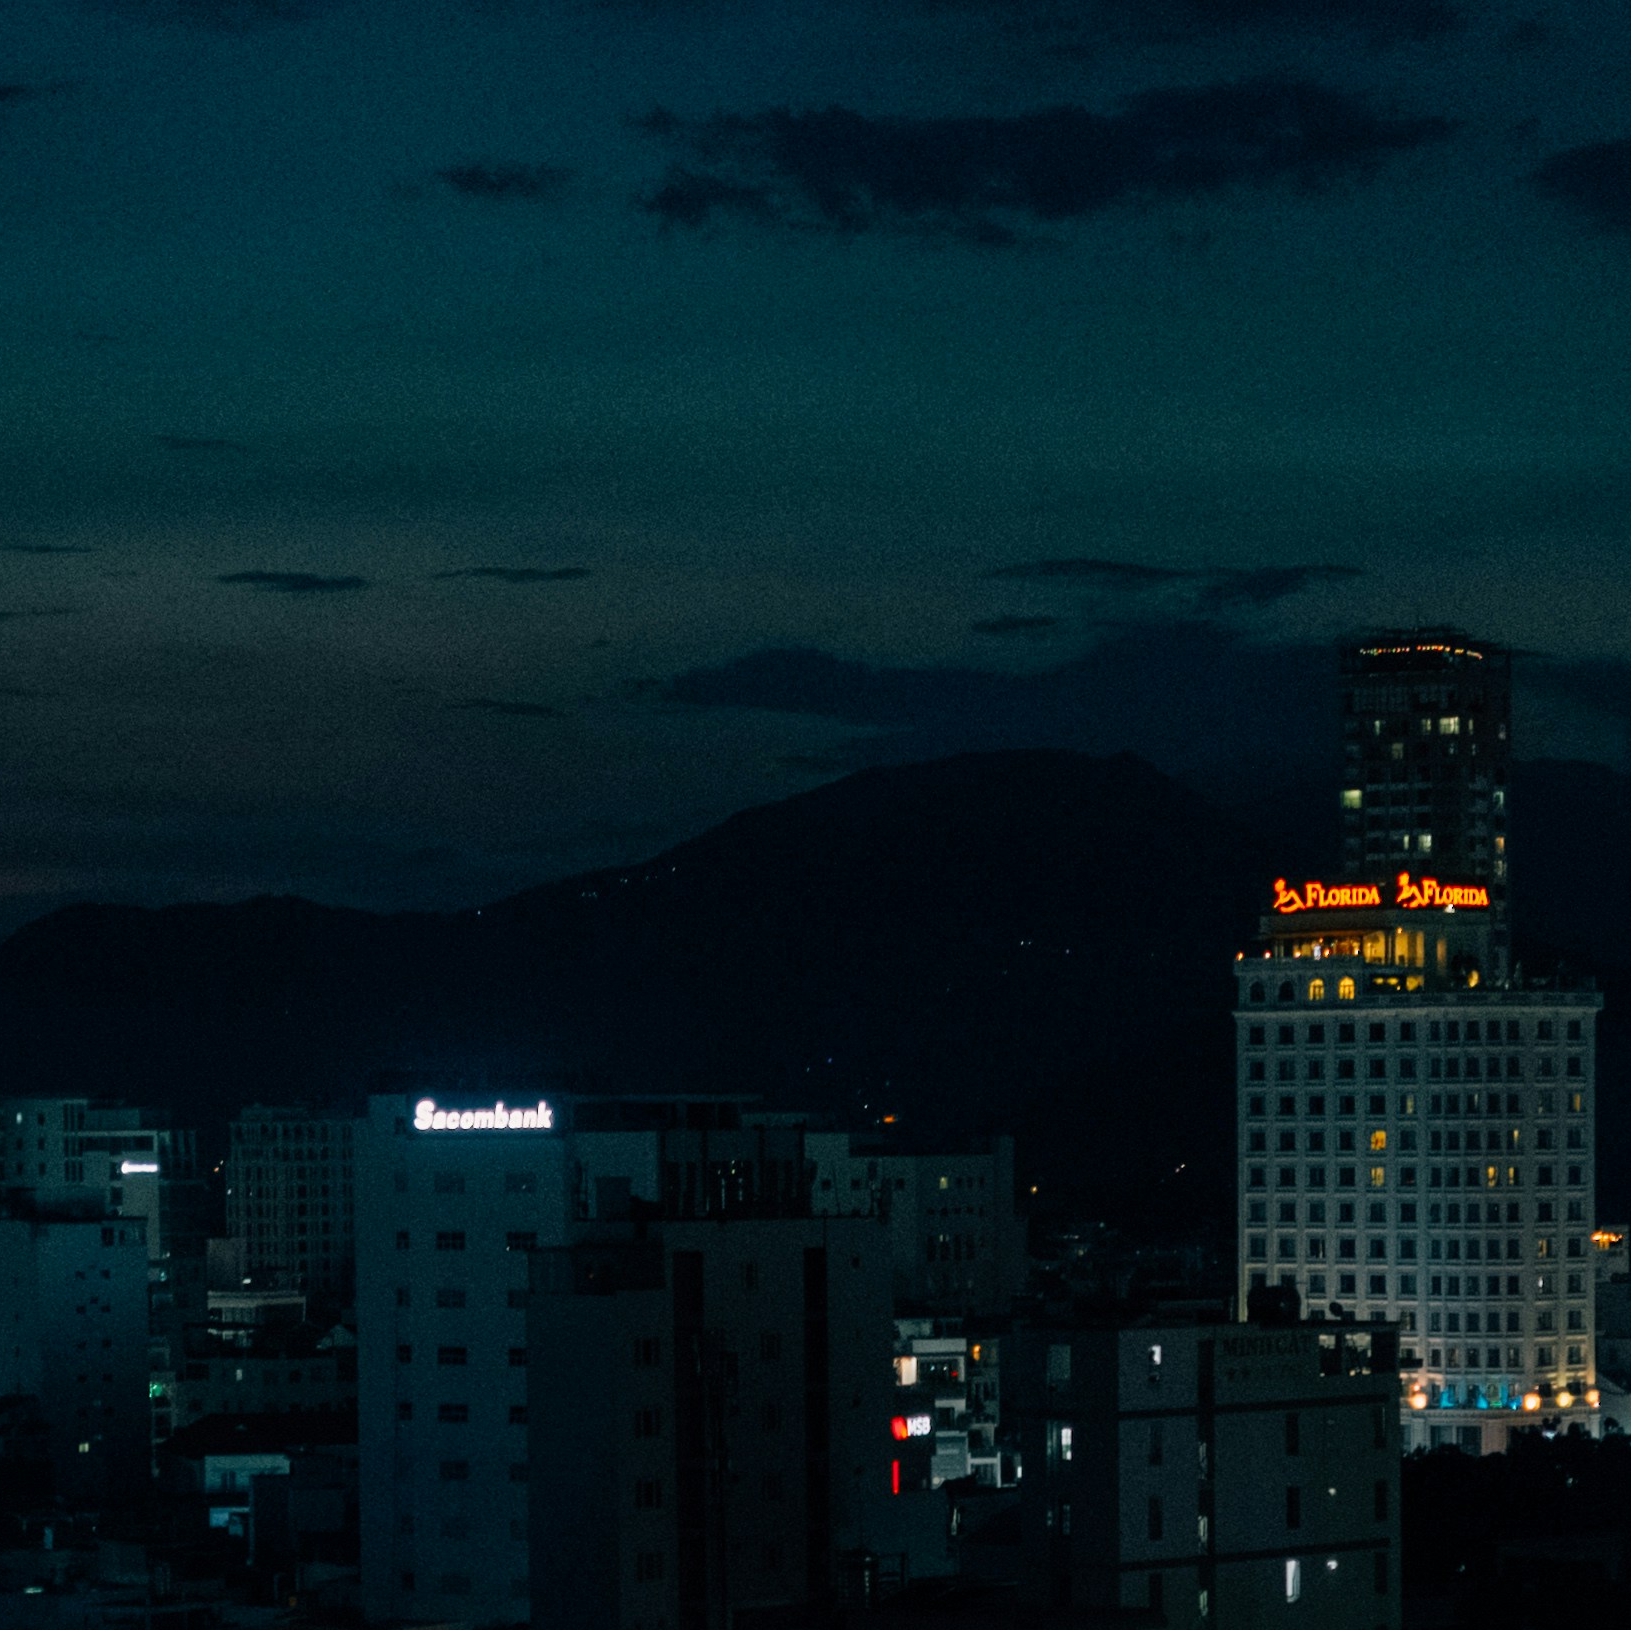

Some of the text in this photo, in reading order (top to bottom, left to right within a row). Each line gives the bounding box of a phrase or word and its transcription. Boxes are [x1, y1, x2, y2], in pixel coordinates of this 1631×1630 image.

[1305, 881, 1381, 907] FLORIDA
[413, 1098, 553, 1130] Sacombank
[906, 1415, 932, 1437] MSB
